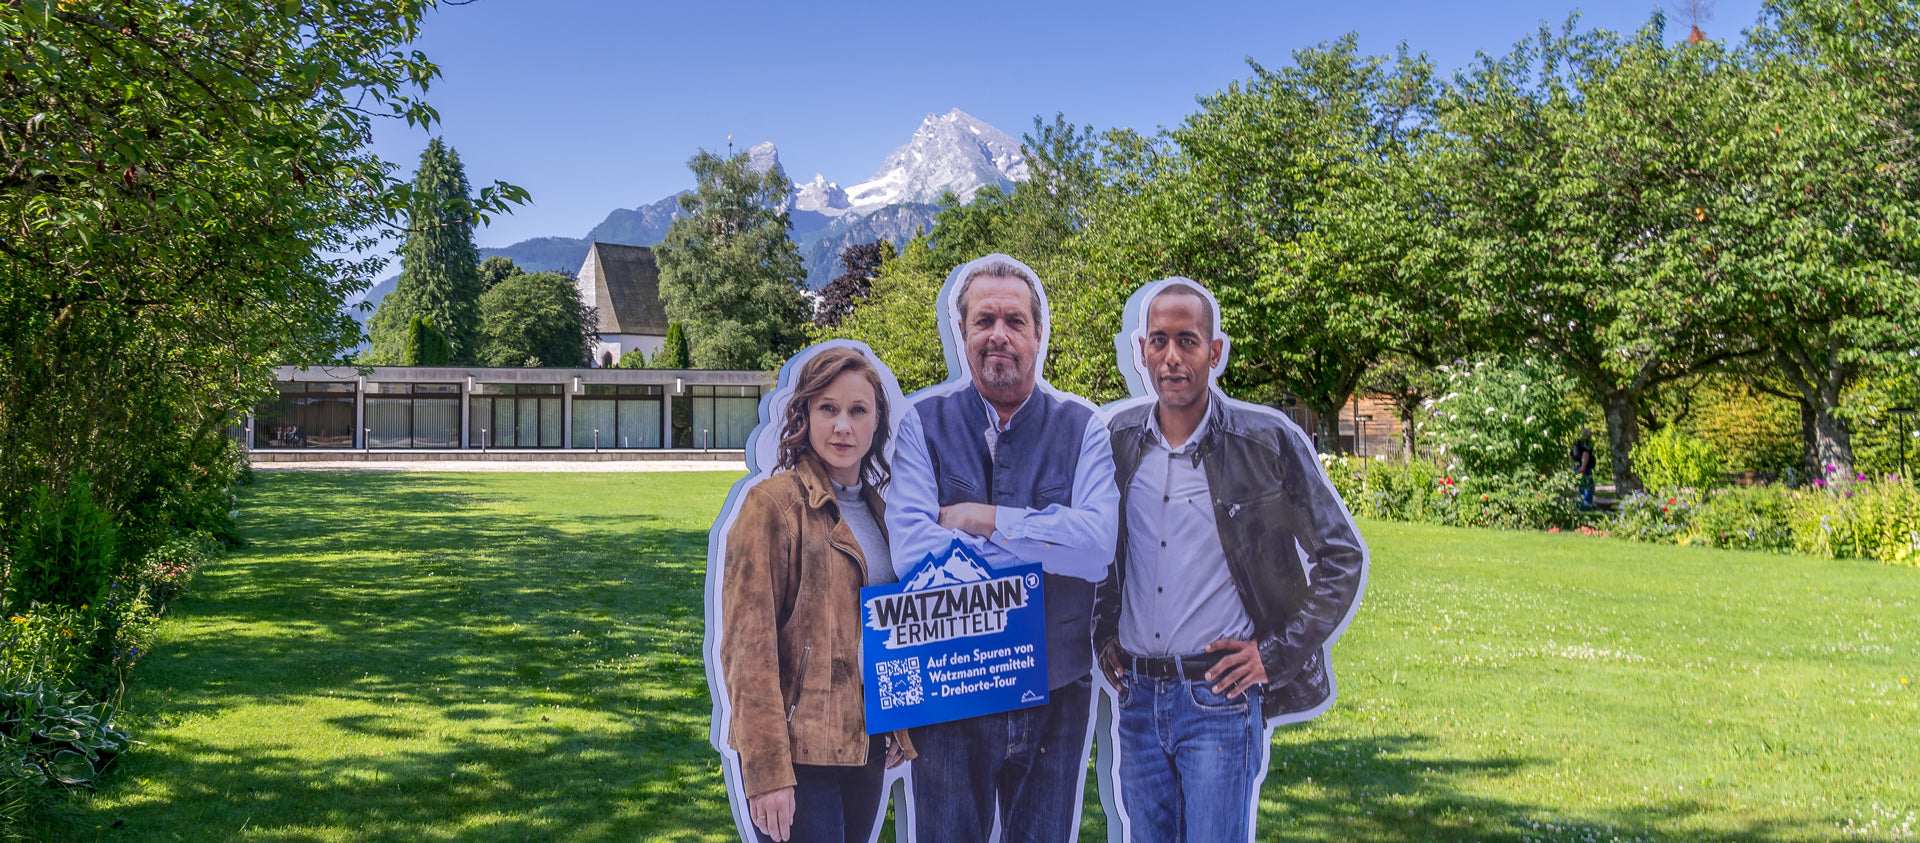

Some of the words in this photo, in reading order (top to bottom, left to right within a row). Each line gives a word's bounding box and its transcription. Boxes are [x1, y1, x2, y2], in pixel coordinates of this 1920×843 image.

[875, 578, 1022, 628] WATZMANN
[896, 611, 1004, 646] ERMITTELT
[927, 654, 947, 669] Auf
[950, 652, 971, 666] den
[973, 646, 1012, 665] Spuren
[1013, 643, 1034, 654] von
[929, 665, 986, 683] Watzmann
[989, 656, 1035, 674] ermittelt
[941, 675, 1017, 698] Drehorte-Tour
